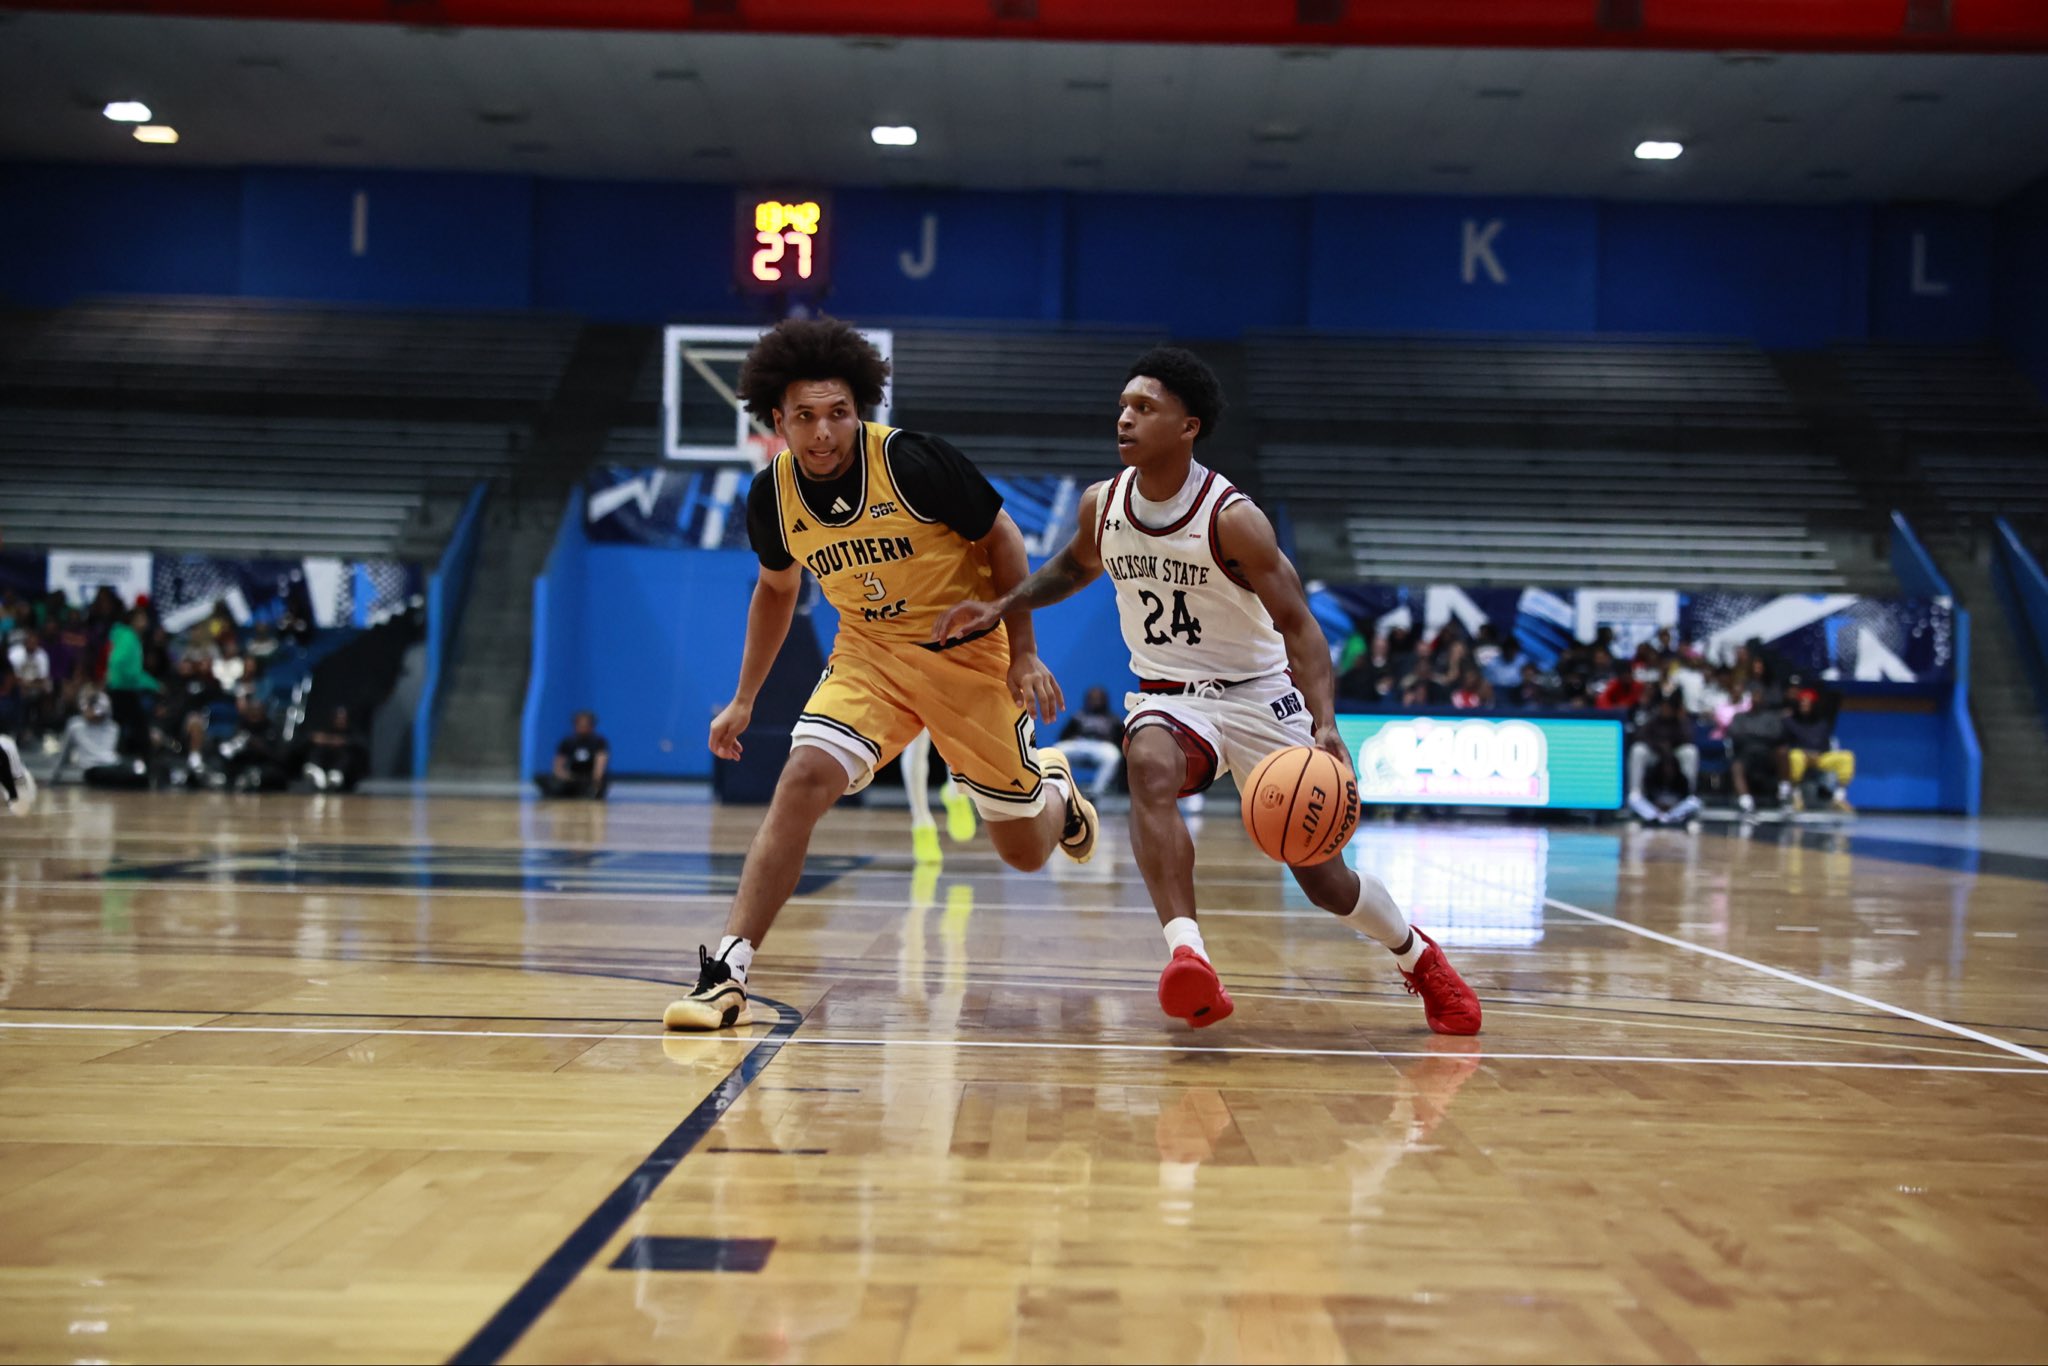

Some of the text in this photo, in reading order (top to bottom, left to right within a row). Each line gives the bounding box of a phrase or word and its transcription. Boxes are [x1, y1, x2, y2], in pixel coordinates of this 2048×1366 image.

[753, 231, 812, 281] 27
[900, 215, 937, 278] J
[1462, 220, 1506, 283] K
[1912, 232, 1949, 295] L
[806, 537, 914, 579] SOUTHERN
[1162, 558, 1210, 586] STATE
[1138, 589, 1202, 645] 24
